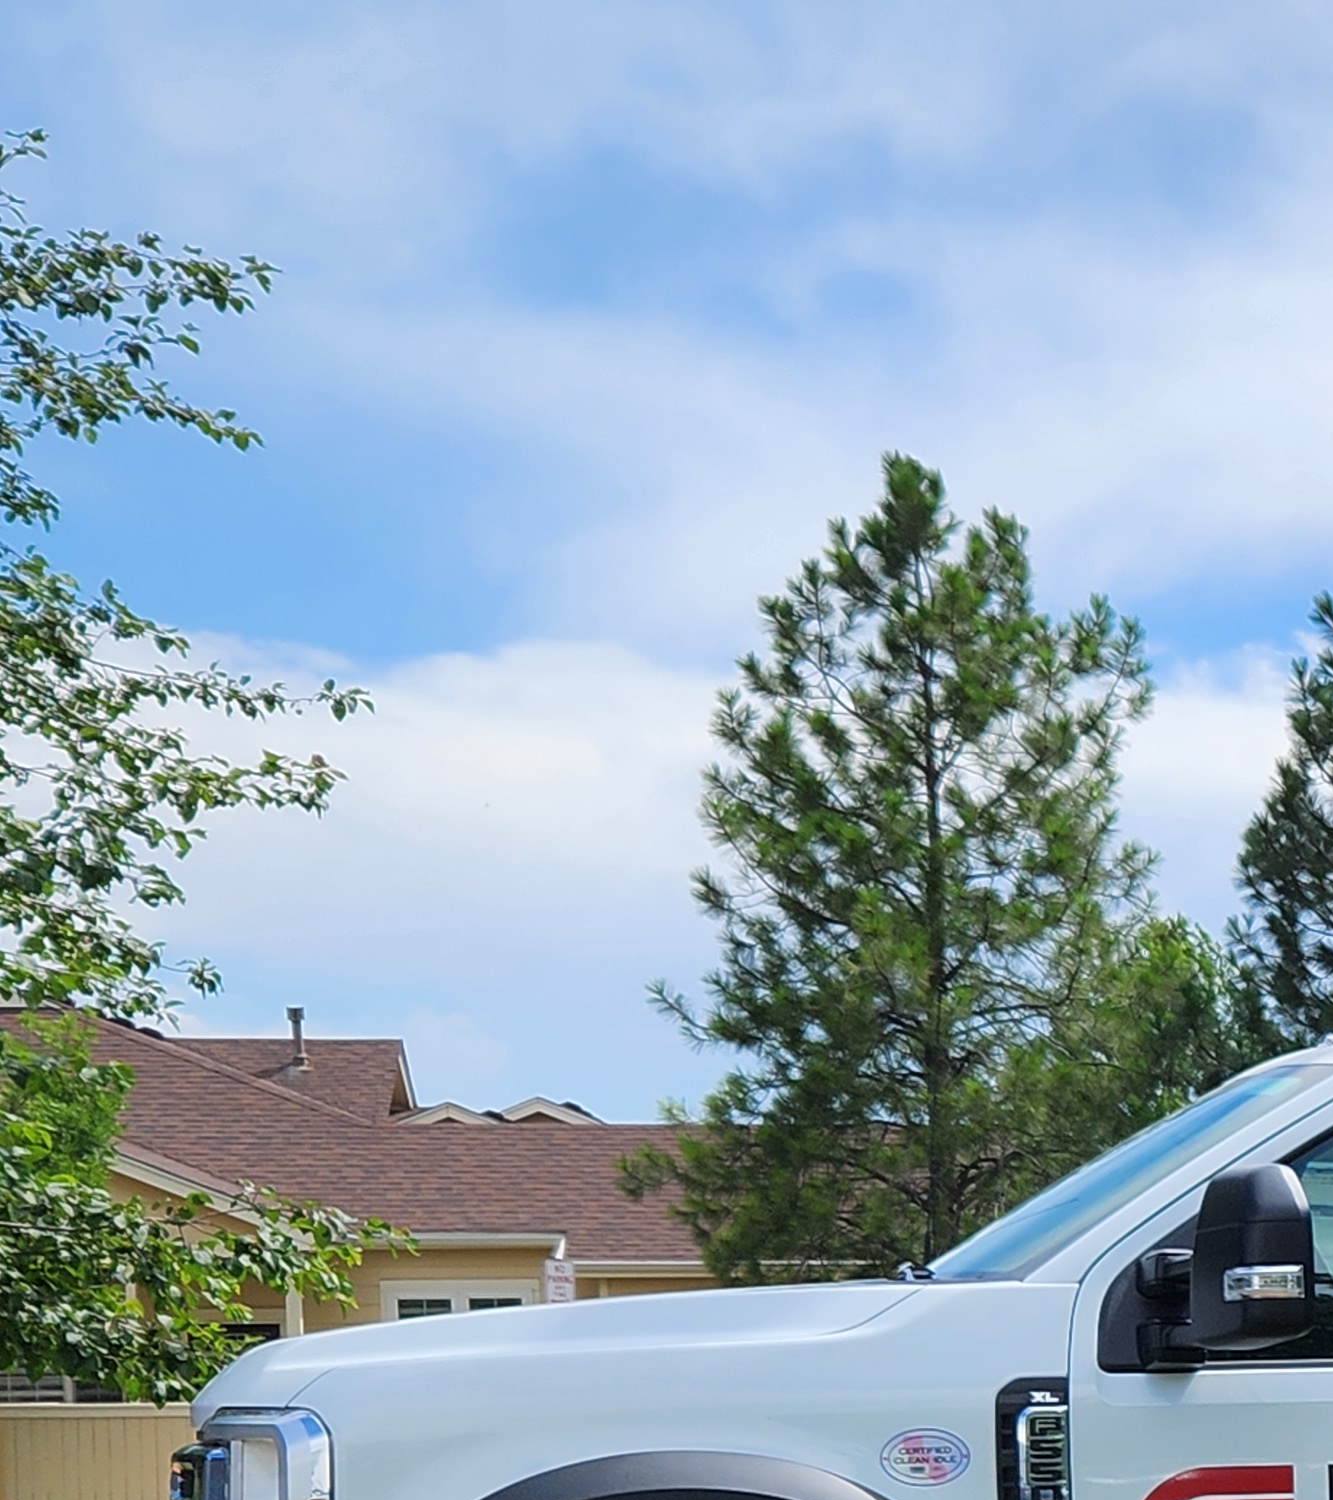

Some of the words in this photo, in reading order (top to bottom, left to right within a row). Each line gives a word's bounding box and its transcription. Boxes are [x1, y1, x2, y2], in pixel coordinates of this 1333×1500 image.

[1029, 1391, 1060, 1403] XL
[898, 1445, 953, 1456] CERTIFIED
[893, 1456, 930, 1465] CLEAN
[932, 1455, 958, 1464] IDLE
